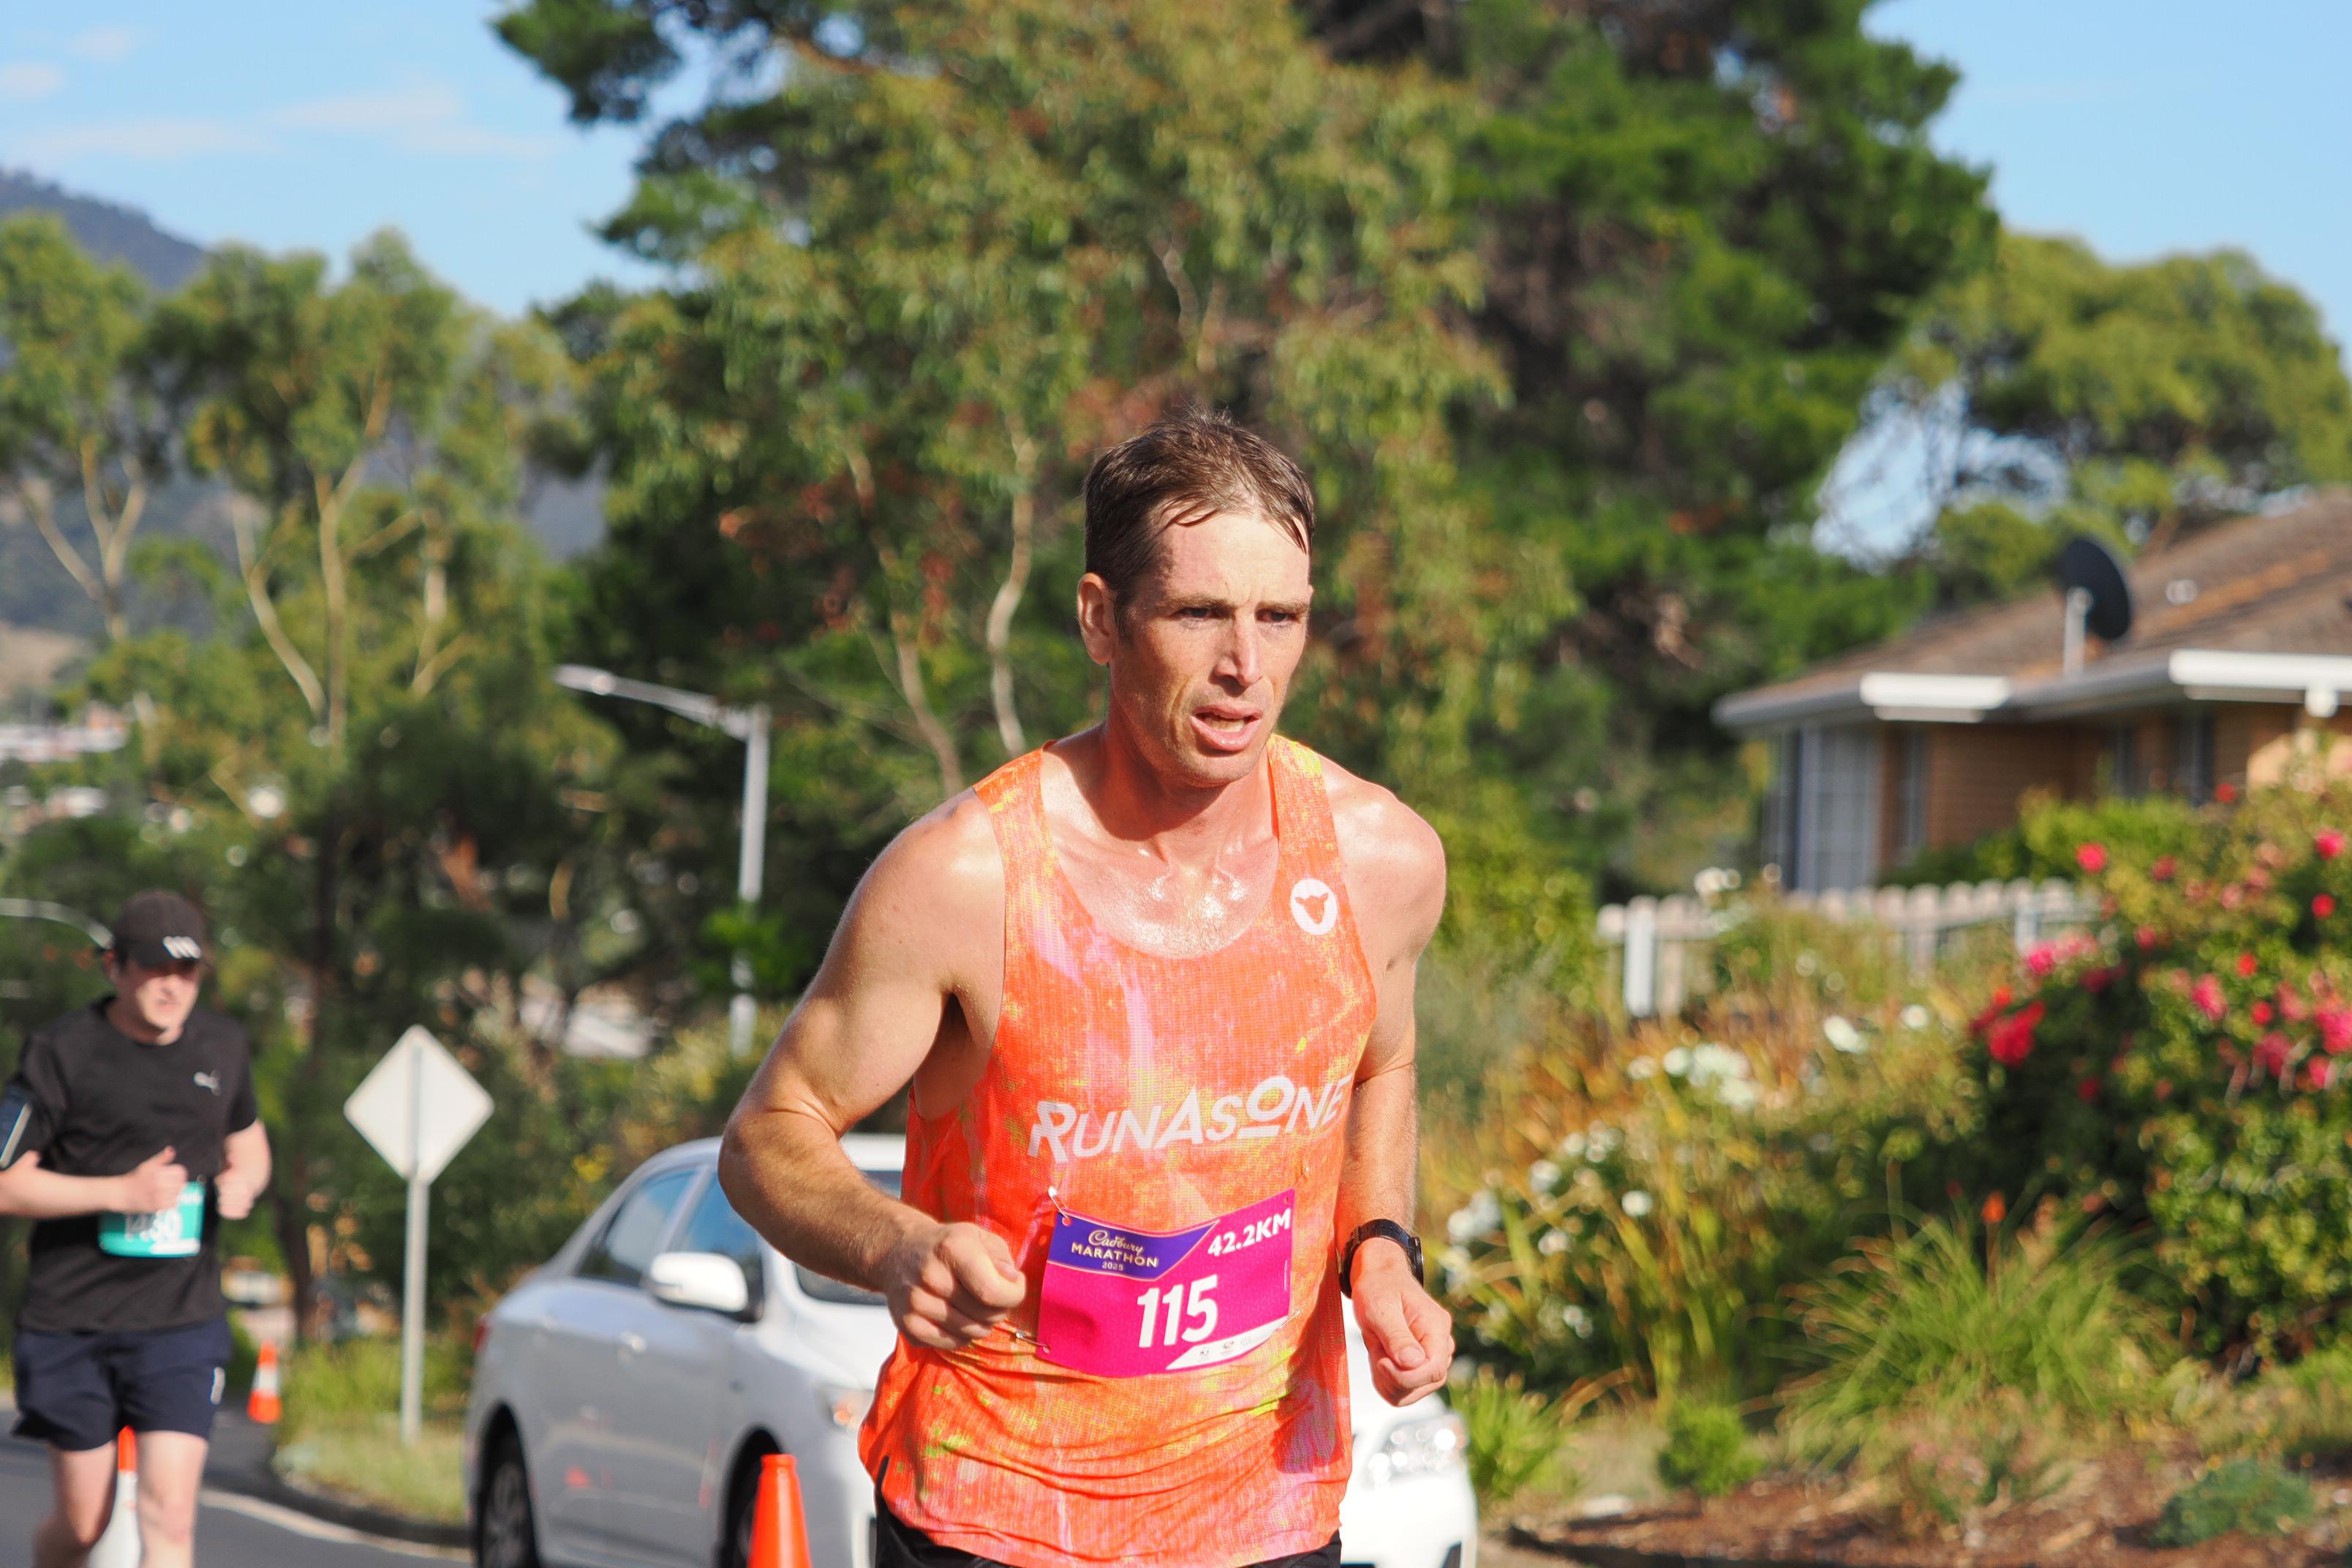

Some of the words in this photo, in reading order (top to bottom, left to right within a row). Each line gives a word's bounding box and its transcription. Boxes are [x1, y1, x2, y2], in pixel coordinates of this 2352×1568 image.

[1088, 1229, 1144, 1256] Cadbury
[1207, 1208, 1291, 1256] 42.2KM
[1071, 1242, 1159, 1267] MARATHON
[1101, 1262, 1123, 1271] 2025
[1137, 1274, 1218, 1348] 115
